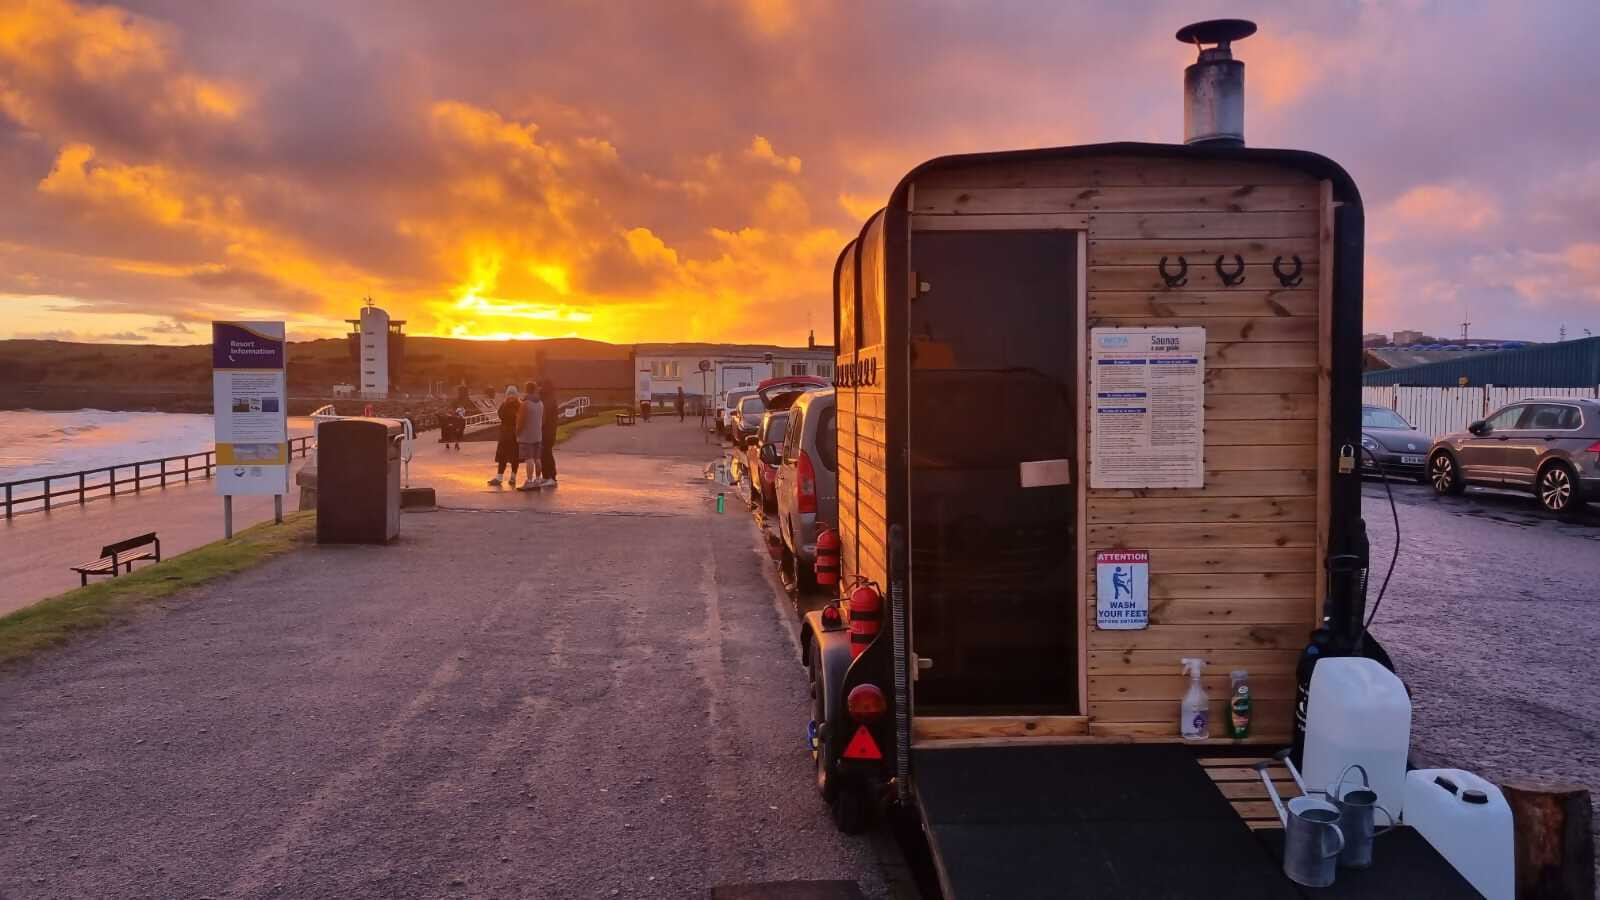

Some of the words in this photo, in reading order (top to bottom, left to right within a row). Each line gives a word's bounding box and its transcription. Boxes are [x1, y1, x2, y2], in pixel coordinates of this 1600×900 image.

[1151, 335, 1180, 345] Saunas
[1098, 553, 1148, 561] ATTENTION
[1110, 601, 1136, 609] WASH
[1099, 610, 1123, 618] YOUR
[1125, 610, 1148, 618] FEET
